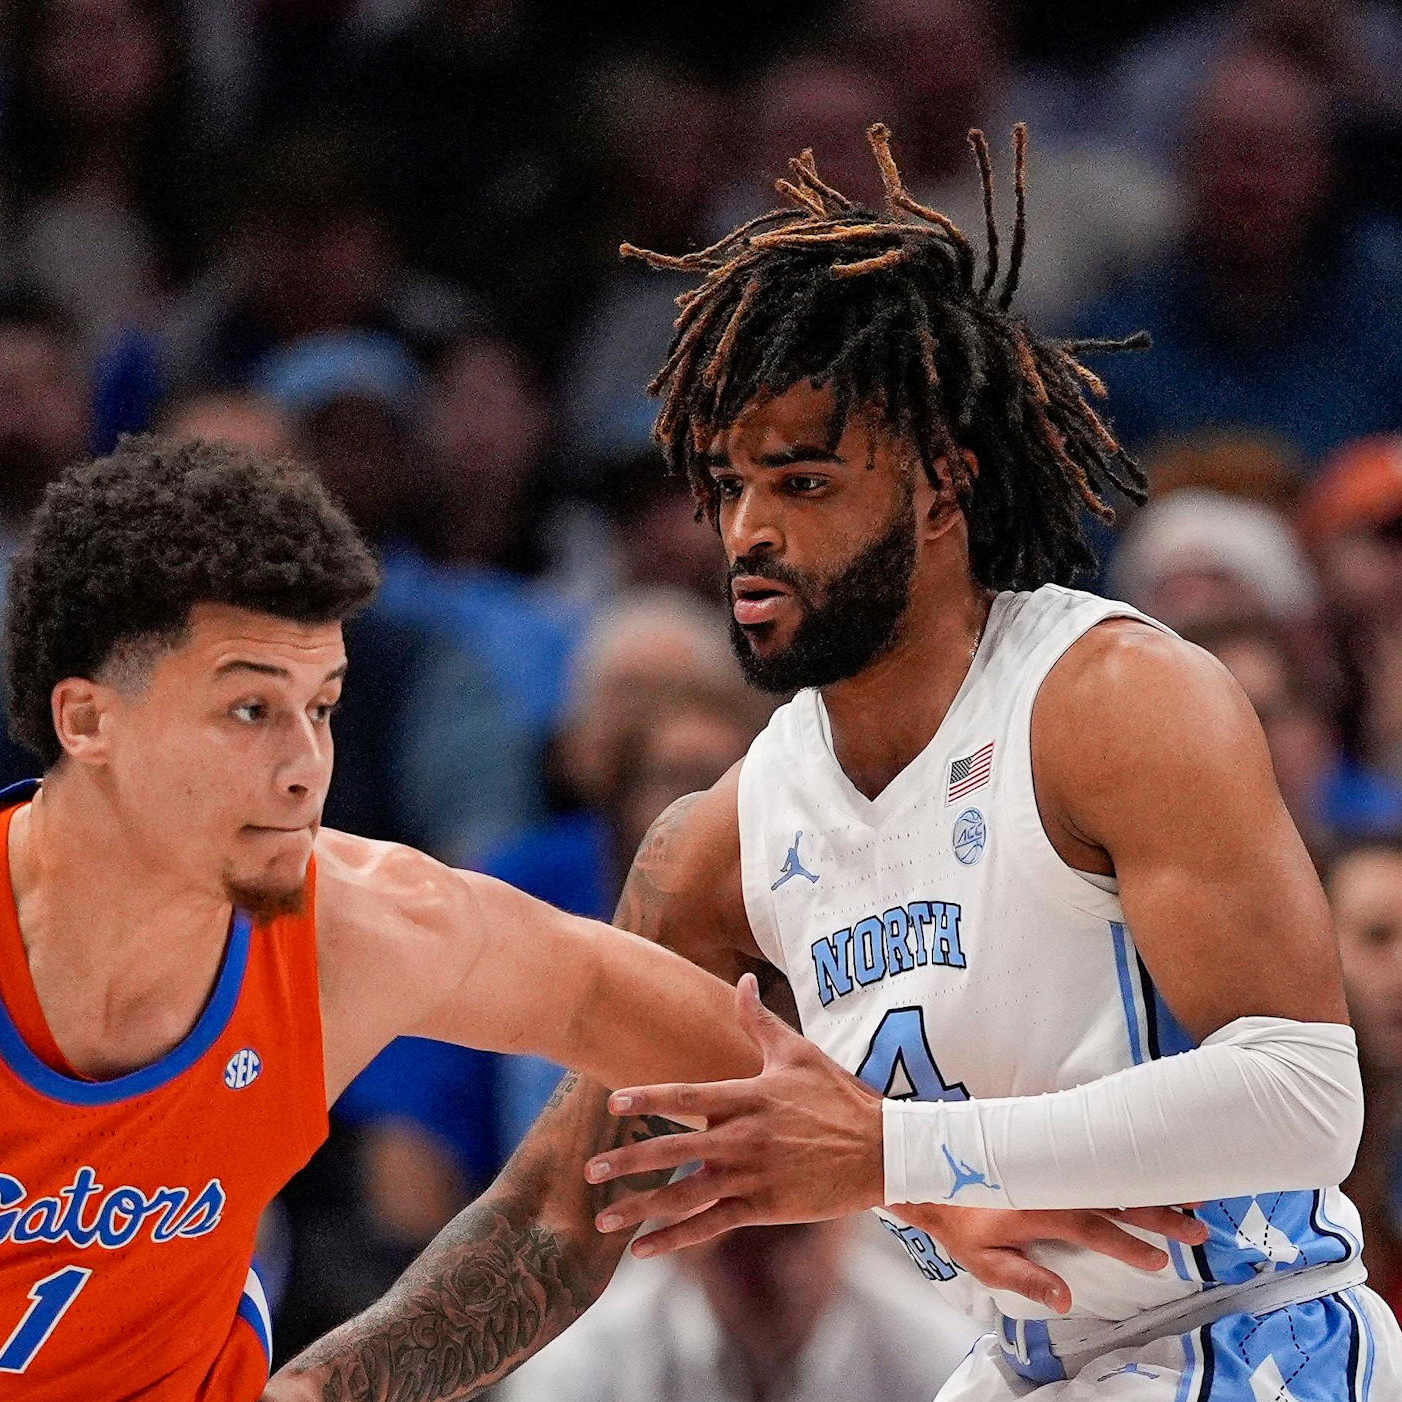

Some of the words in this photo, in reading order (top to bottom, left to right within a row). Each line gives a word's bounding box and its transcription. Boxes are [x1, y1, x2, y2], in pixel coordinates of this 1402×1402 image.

[811, 900, 966, 1007] NORTH
[225, 1049, 261, 1088] SEC
[855, 1005, 971, 1102] 4
